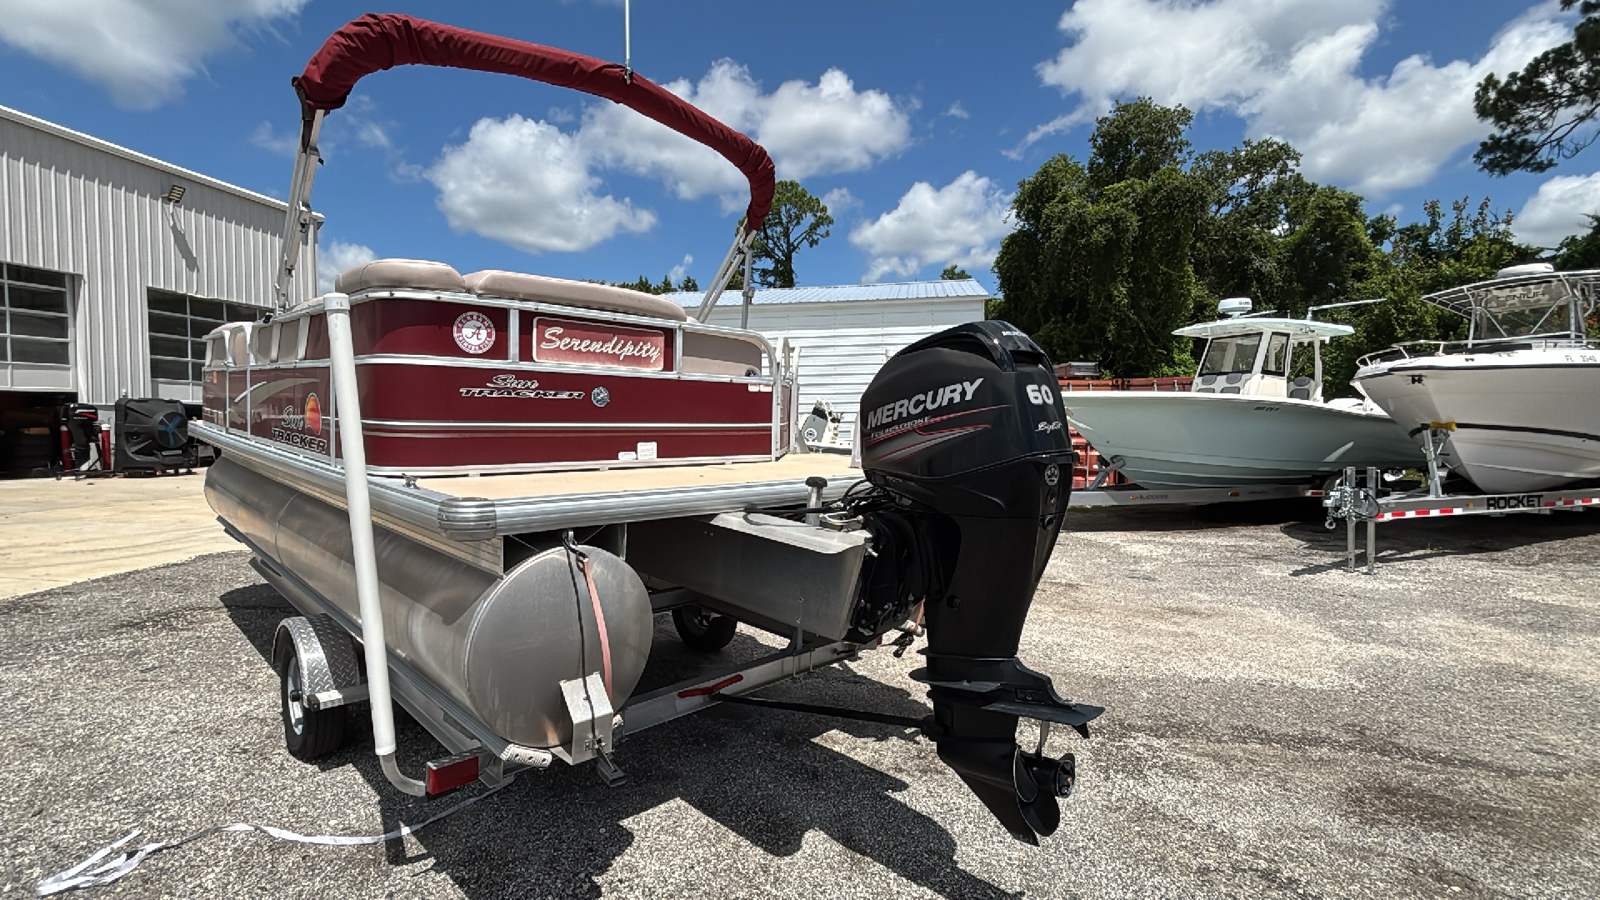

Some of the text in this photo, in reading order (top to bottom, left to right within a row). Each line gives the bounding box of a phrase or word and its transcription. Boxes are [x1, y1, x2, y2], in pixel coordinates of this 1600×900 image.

[540, 327, 661, 363] Serendipity
[486, 374, 539, 388] Sun
[459, 387, 585, 399] TRACKER
[866, 377, 984, 430] MERCURY
[1026, 384, 1054, 405] 60
[281, 405, 304, 430] Sun
[271, 427, 327, 454] TRACKER
[1486, 494, 1543, 511] ROCKET
